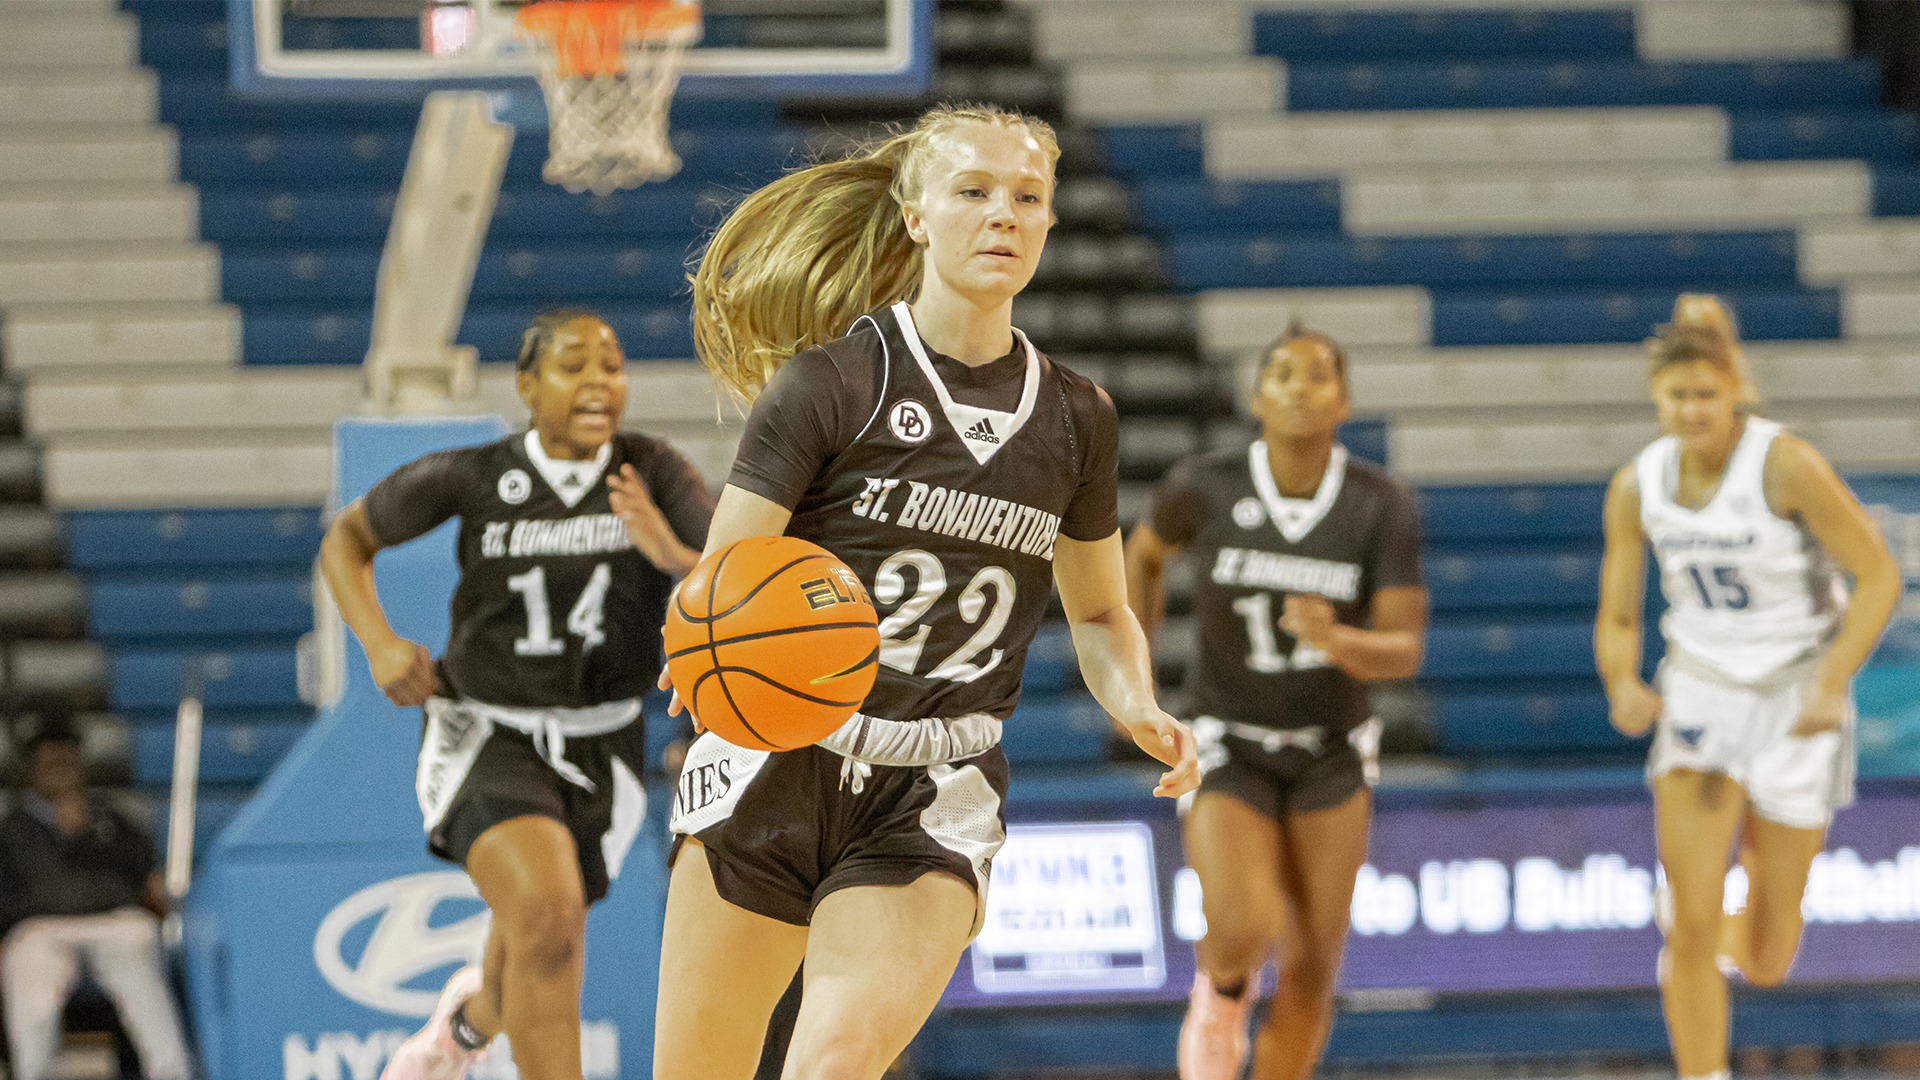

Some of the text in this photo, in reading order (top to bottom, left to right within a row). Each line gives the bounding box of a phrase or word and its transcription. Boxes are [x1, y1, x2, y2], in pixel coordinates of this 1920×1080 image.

[964, 429, 1000, 444] adidas
[852, 477, 900, 522] ST.
[507, 564, 612, 656] 14
[874, 549, 1016, 683] 22
[1688, 566, 1750, 609] 15
[1513, 853, 1653, 932] Bulls
